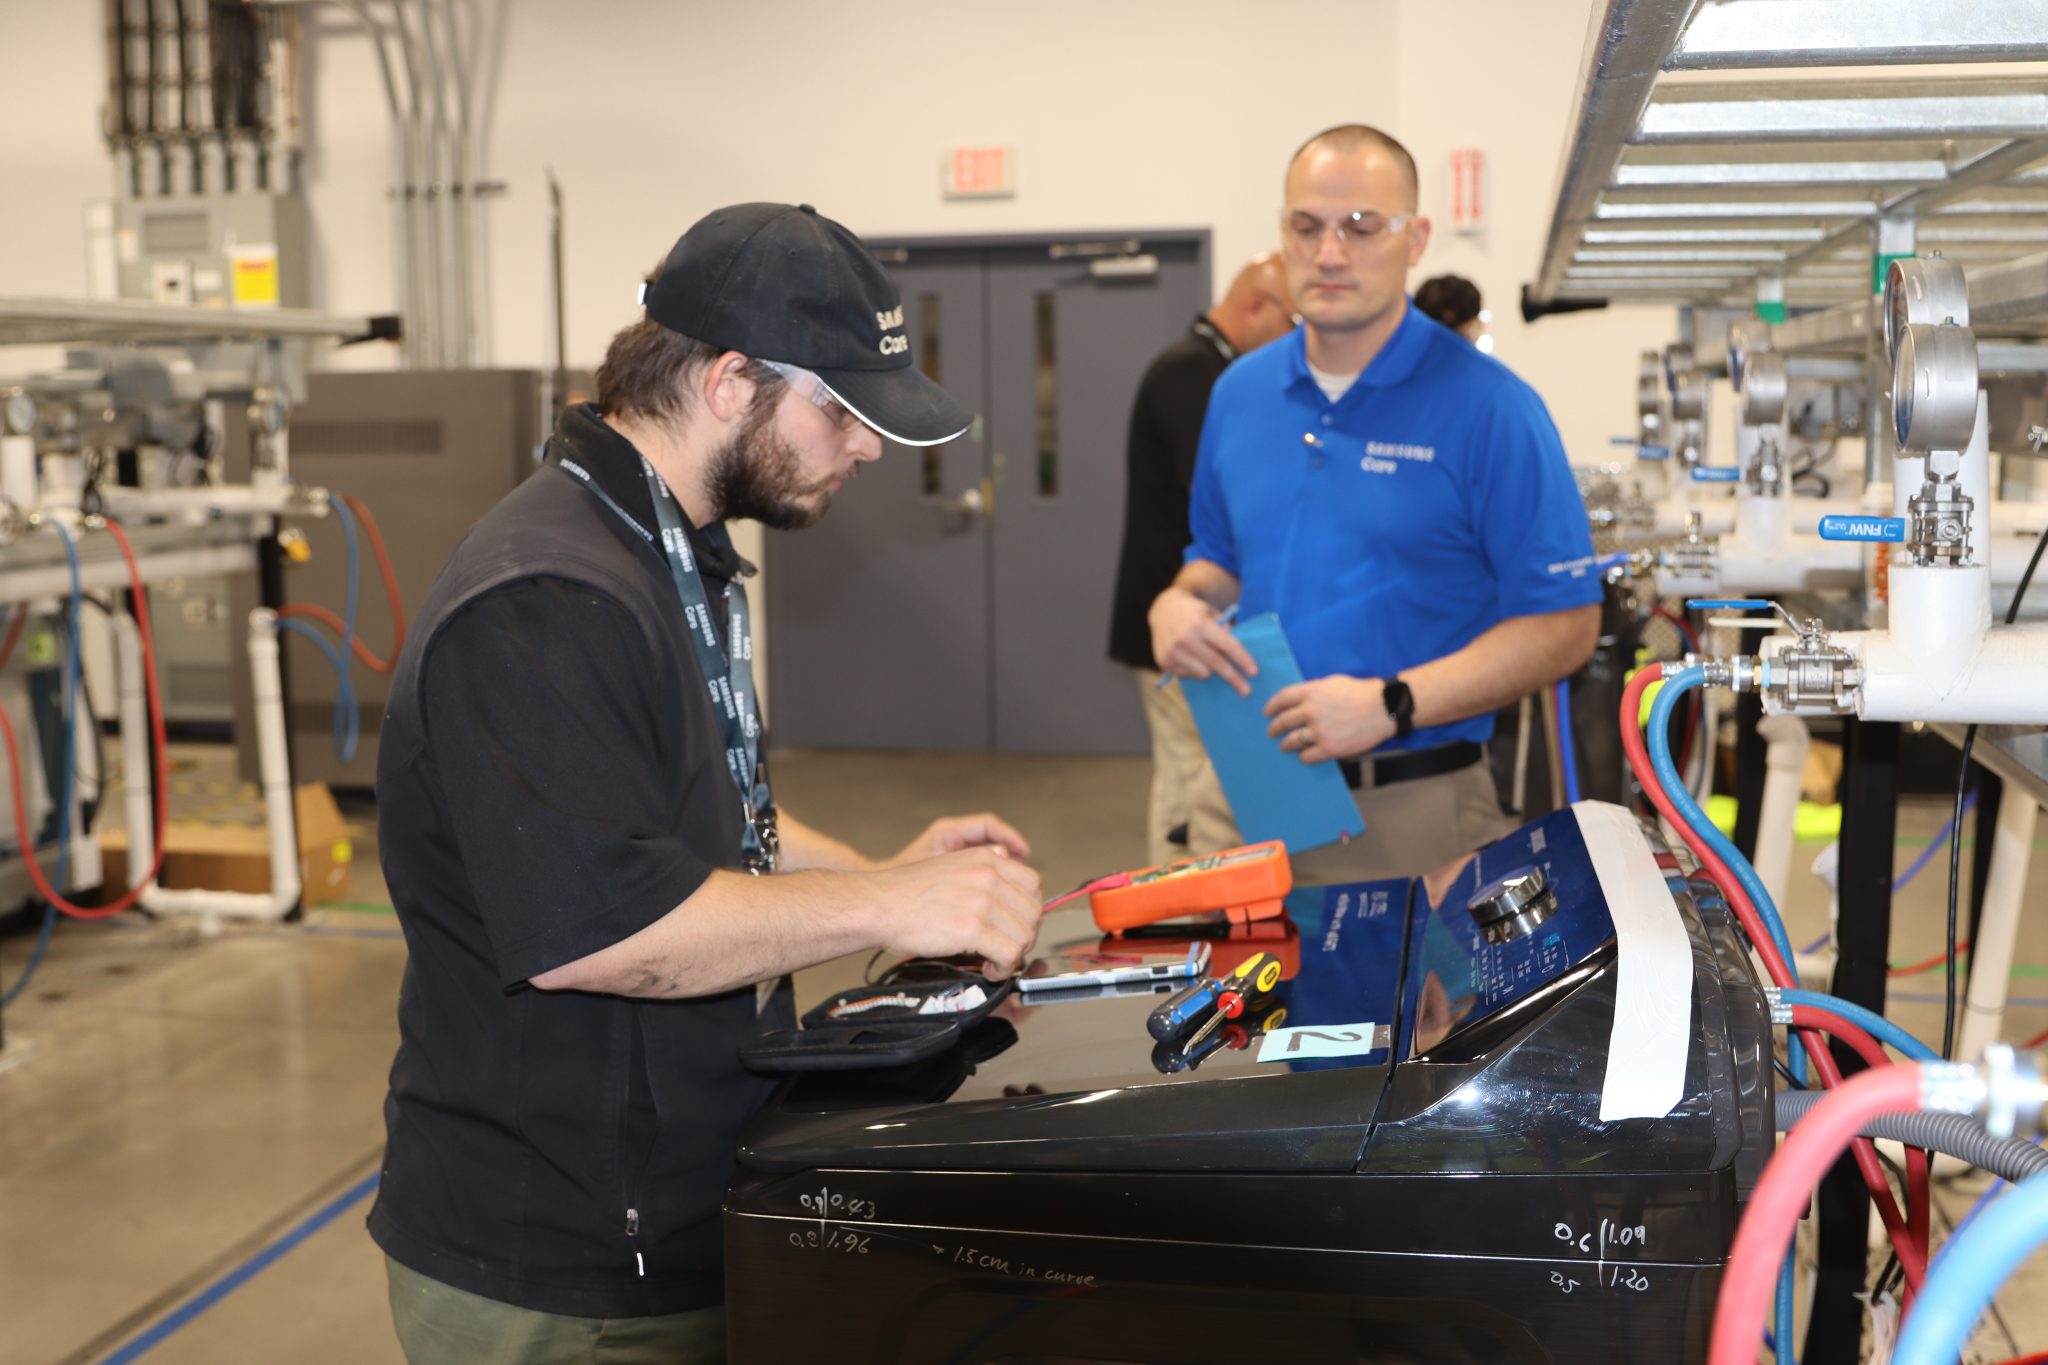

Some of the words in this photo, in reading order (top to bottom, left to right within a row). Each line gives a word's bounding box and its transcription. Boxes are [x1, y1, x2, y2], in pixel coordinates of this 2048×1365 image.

[661, 528, 675, 554] Care
[1849, 522, 1882, 537] FNW
[672, 527, 693, 573] SAMSUNG
[684, 605, 698, 629] Care
[695, 603, 716, 648] SAMSUNG
[732, 613, 743, 659] SAMSUNG
[708, 679, 721, 703] Care
[718, 675, 737, 719] SAMSUNG
[1554, 1222, 1592, 1253] 0.6
[1610, 1265, 1649, 1292] 1.20
